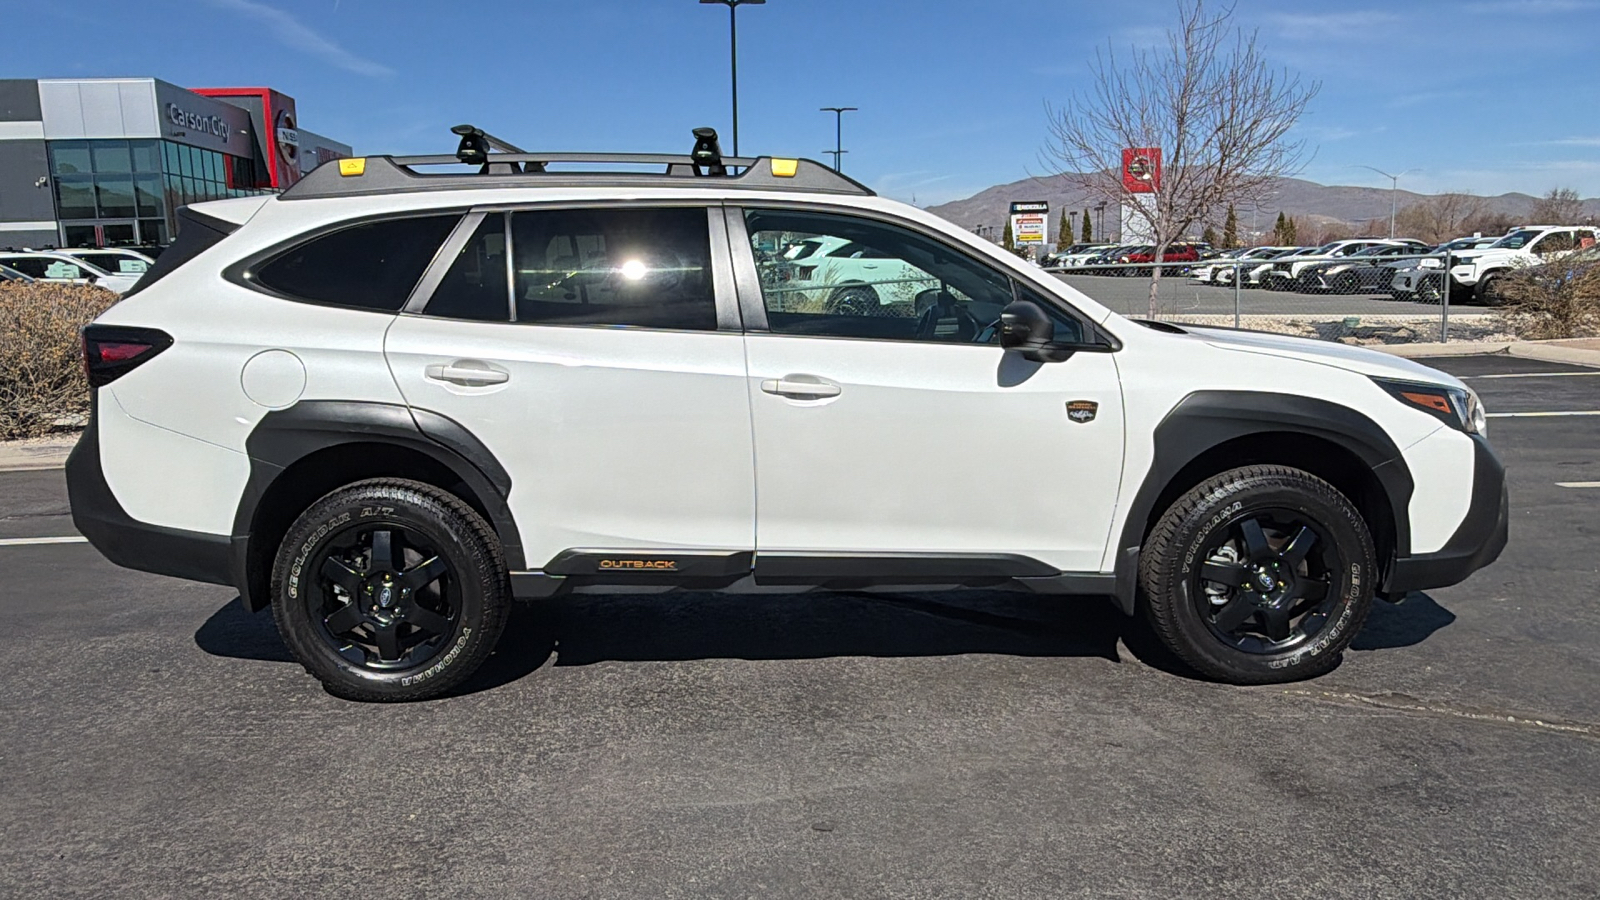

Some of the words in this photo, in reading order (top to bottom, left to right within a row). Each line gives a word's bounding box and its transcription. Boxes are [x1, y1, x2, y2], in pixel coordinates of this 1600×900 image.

[170, 103, 210, 133] Carson
[211, 115, 230, 143] City
[287, 512, 351, 599] GEOLANDAR
[600, 559, 675, 568] OUTBACK
[1181, 501, 1243, 574] YOKOHAMA
[401, 627, 472, 686] YOKOHAMA
